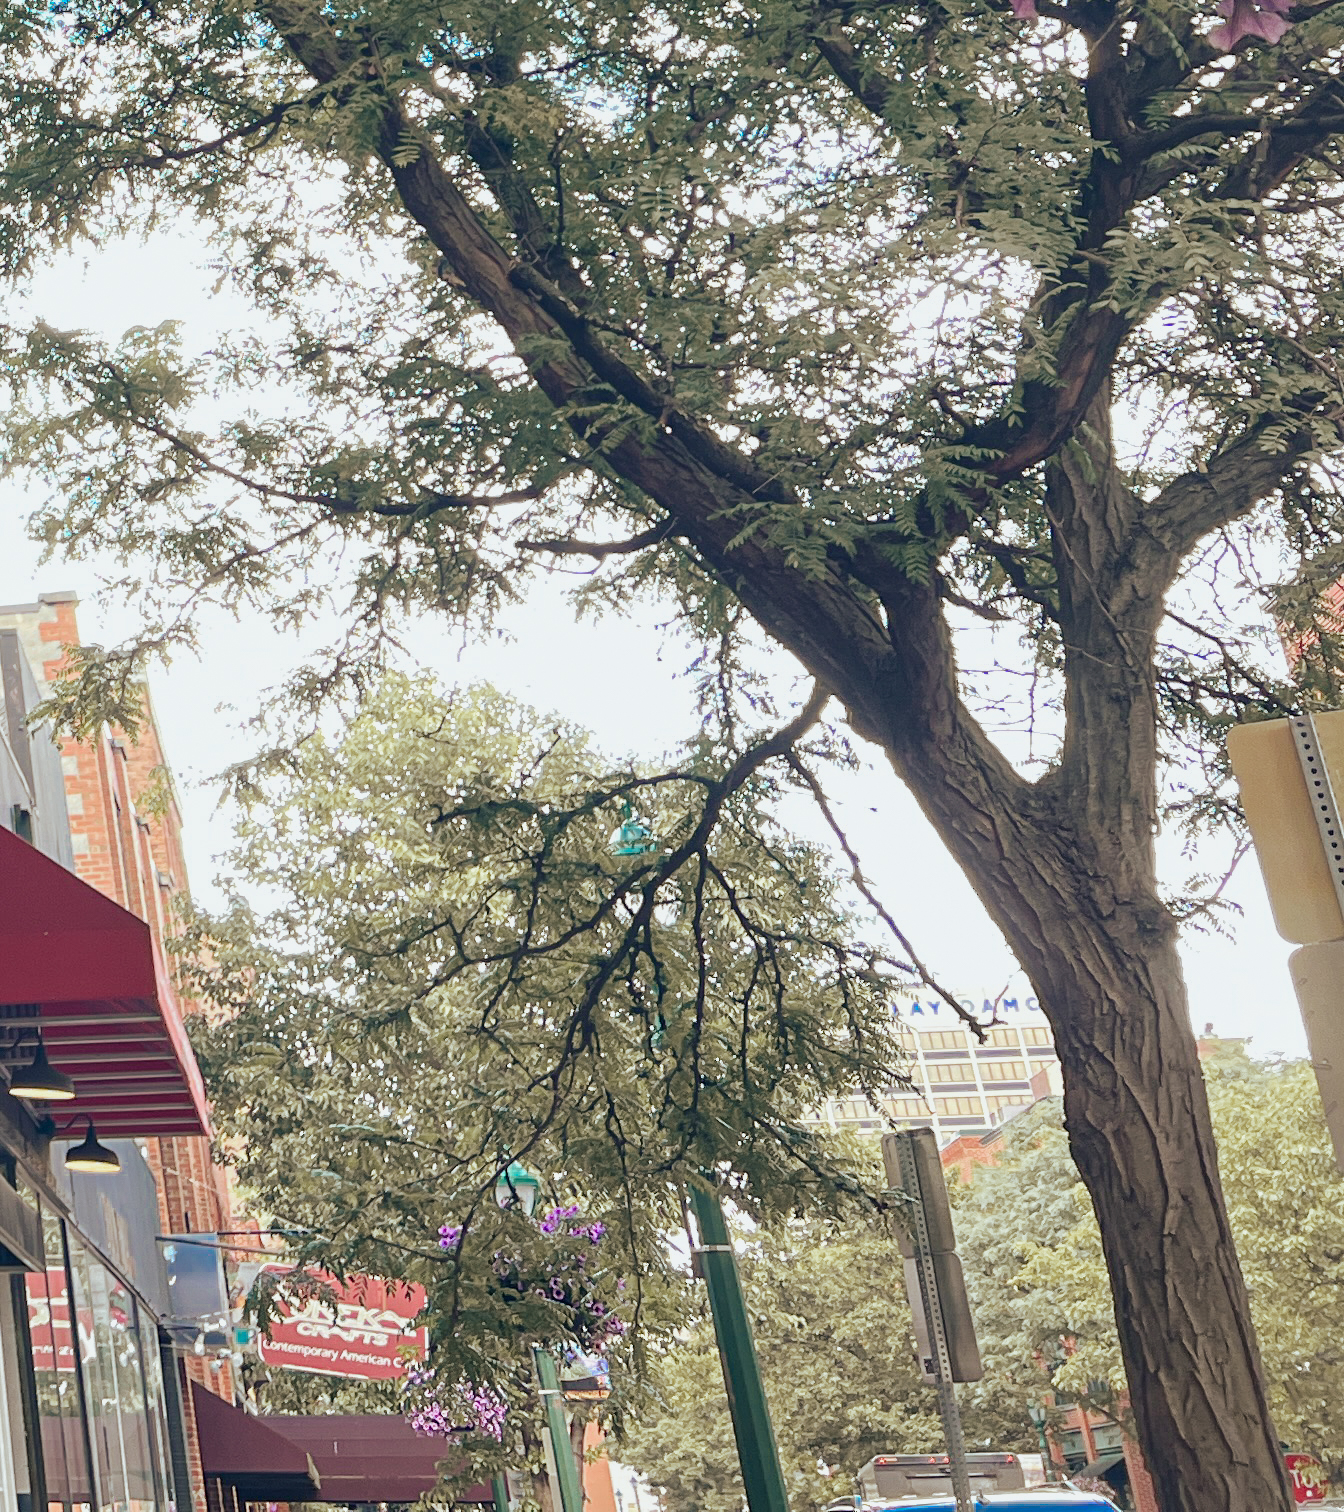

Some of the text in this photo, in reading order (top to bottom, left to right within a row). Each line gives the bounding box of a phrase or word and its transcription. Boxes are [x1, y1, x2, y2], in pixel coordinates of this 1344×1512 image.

[296, 1322, 389, 1347] CRAFTS
[263, 1340, 339, 1362] Contemporary
[340, 1348, 391, 1368] American
